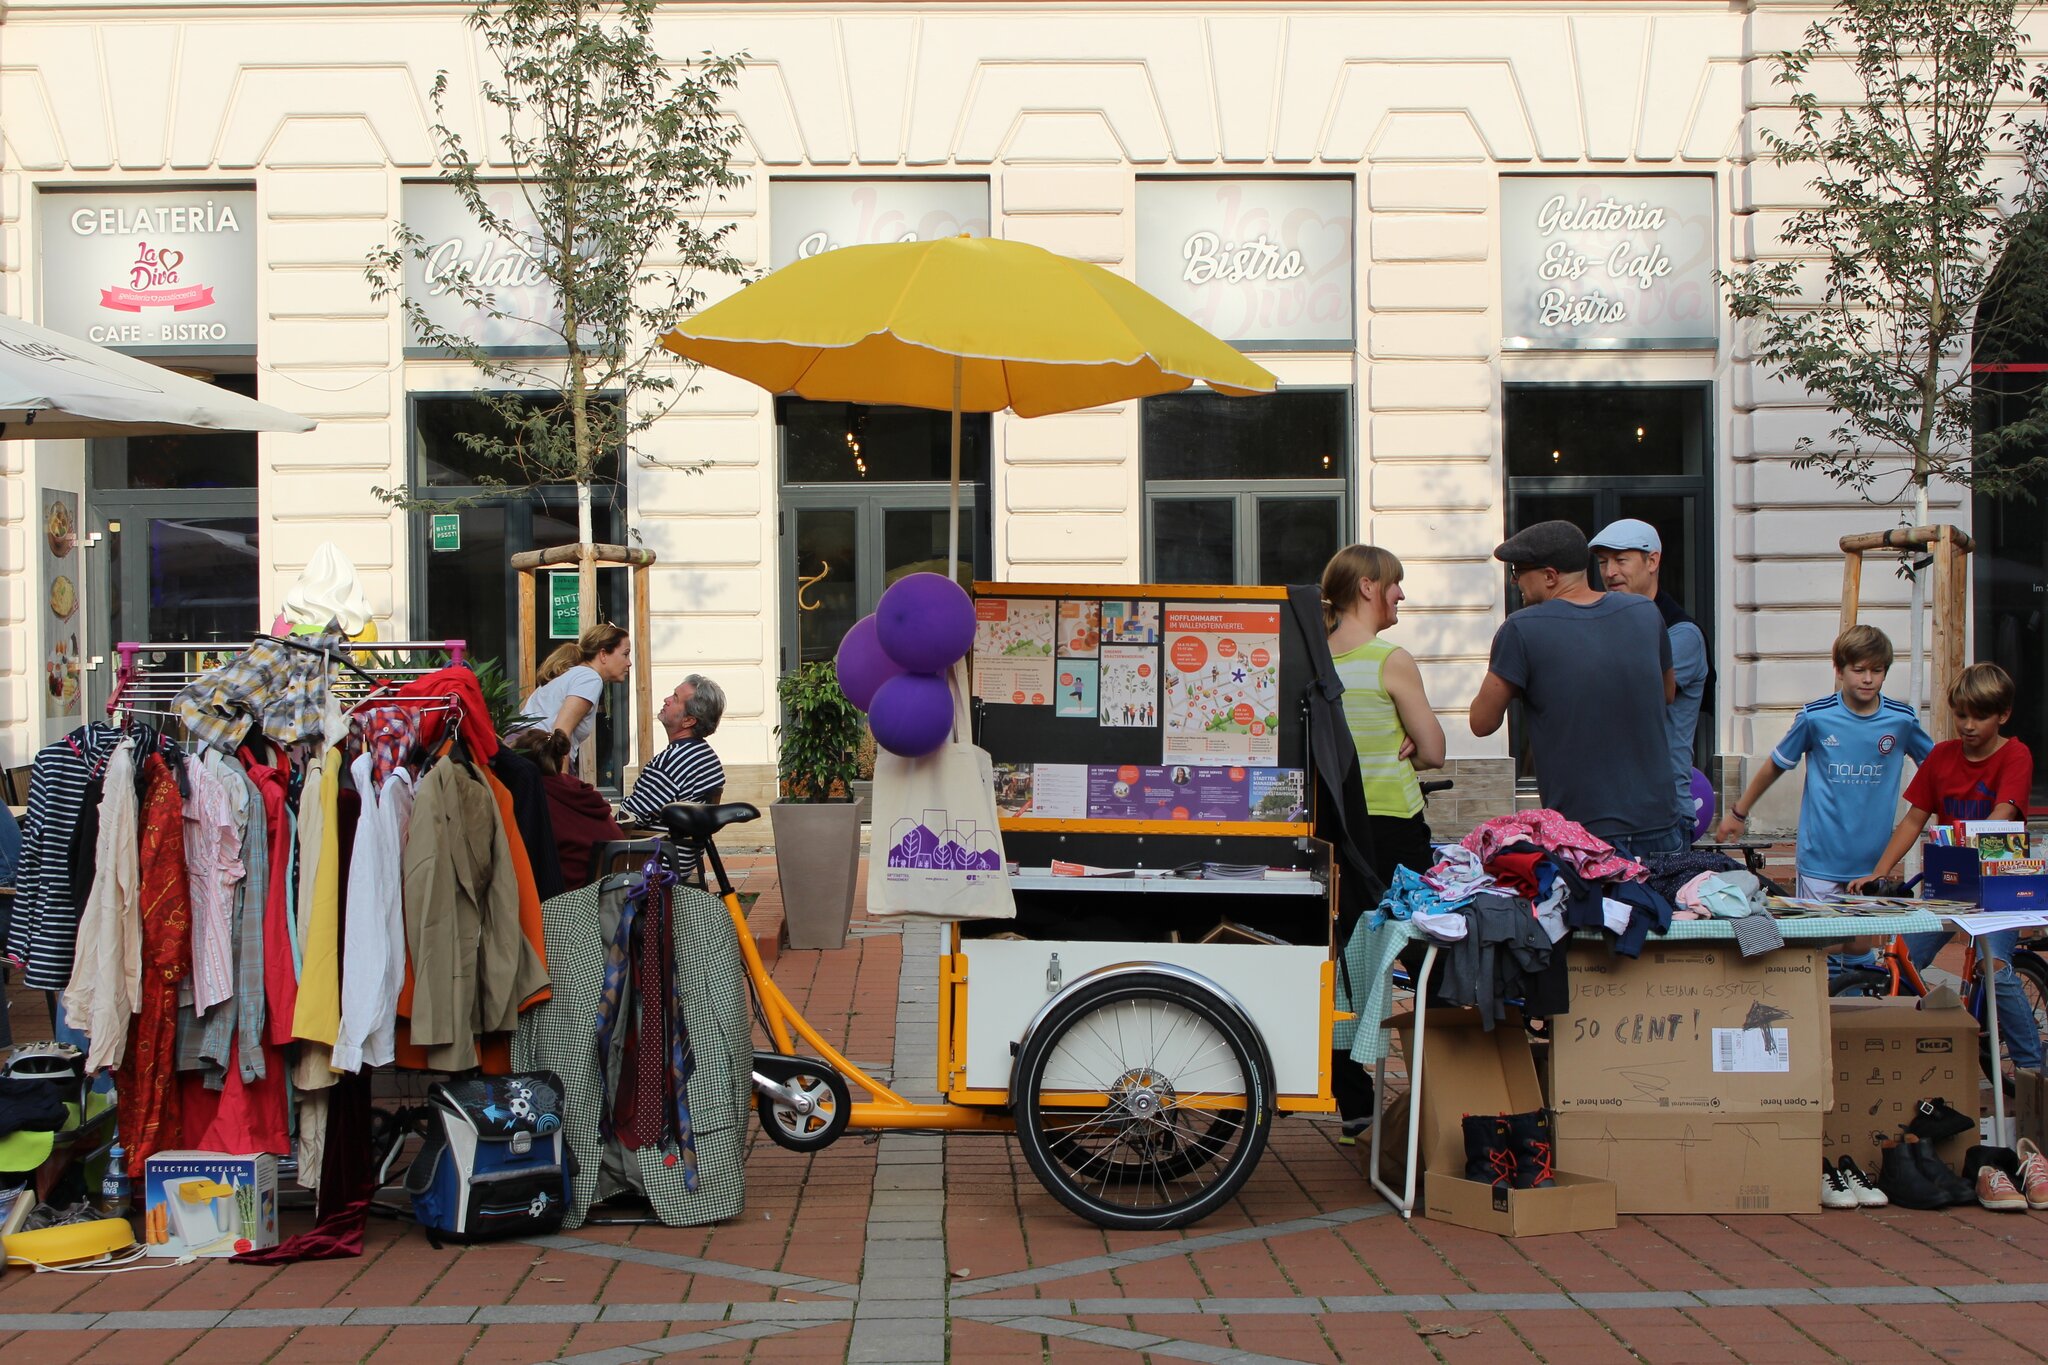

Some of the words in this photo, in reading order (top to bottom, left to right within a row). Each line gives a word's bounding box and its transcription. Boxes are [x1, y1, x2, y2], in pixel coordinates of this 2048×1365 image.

[1537, 195, 1667, 236] Gelateria
[134, 241, 158, 267] La
[1183, 231, 1305, 284] Bistro
[1538, 241, 1672, 289] Eis-Cafe
[129, 266, 180, 291] Diva
[1539, 288, 1626, 327] Bistro
[89, 325, 141, 343] CAFE
[161, 323, 227, 341] BISTRO
[554, 592, 579, 606] BITT
[1169, 614, 1223, 622] HOFFLOHMARKT
[1179, 622, 1245, 630] WALLENSTEINVIERTEL
[1765, 966, 1787, 974] here!
[1788, 964, 1812, 974] Open
[1575, 1017, 1600, 1042] 50
[1576, 1099, 1599, 1107] here!
[1599, 1097, 1623, 1107] Open
[1760, 1099, 1784, 1107] here!
[1785, 1097, 1808, 1107] Open
[151, 1165, 200, 1173] ELECTRIC
[205, 1165, 243, 1173] PEELER
